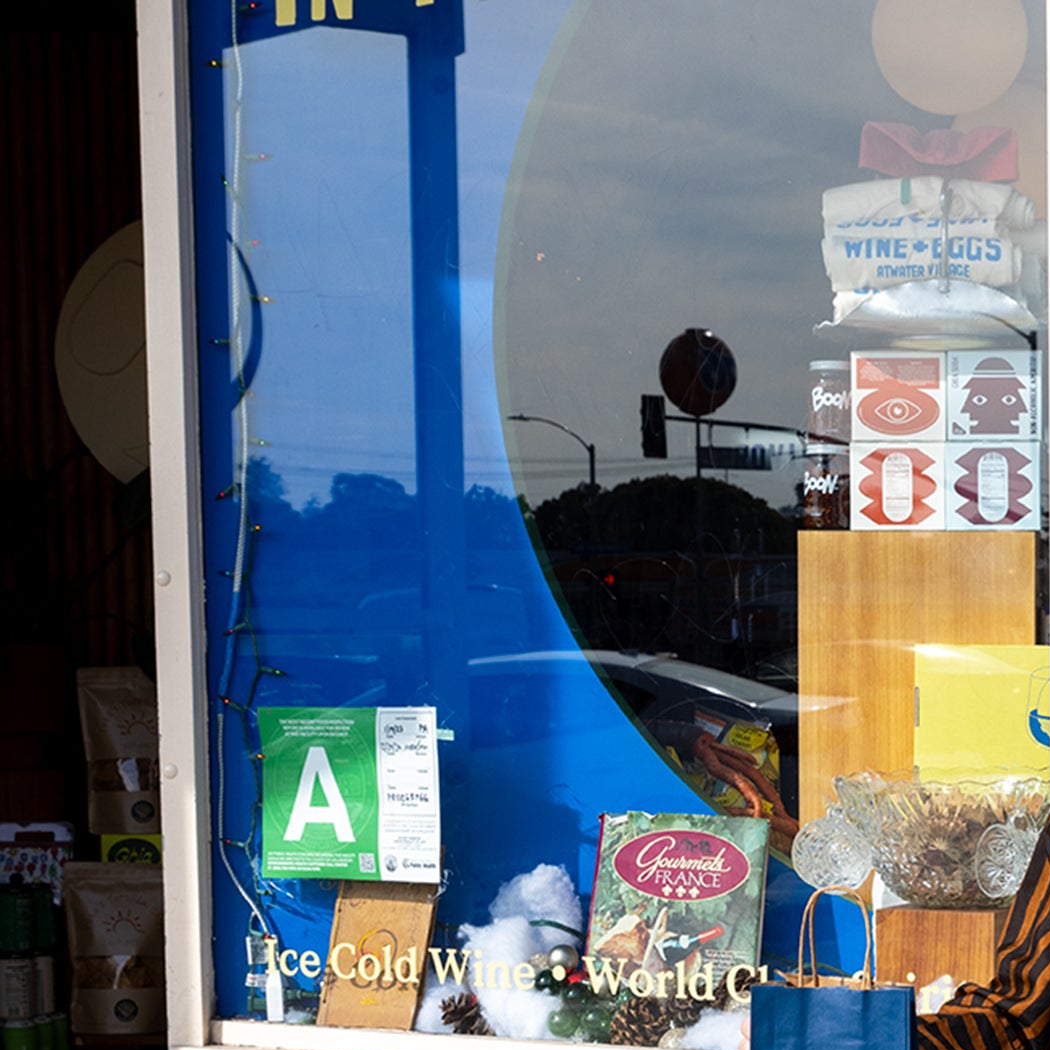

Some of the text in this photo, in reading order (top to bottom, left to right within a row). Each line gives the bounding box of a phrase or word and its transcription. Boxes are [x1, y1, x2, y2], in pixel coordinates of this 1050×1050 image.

[845, 237, 907, 259] WINE
[932, 236, 1002, 262] EGGS
[877, 262, 970, 278] ATWATER VIAGE
[283, 746, 356, 843] A
[655, 869, 722, 888] FRANCE
[264, 938, 321, 978] Ice
[330, 942, 420, 984] Cold
[428, 947, 536, 990] Wine
[581, 955, 716, 1001] World
